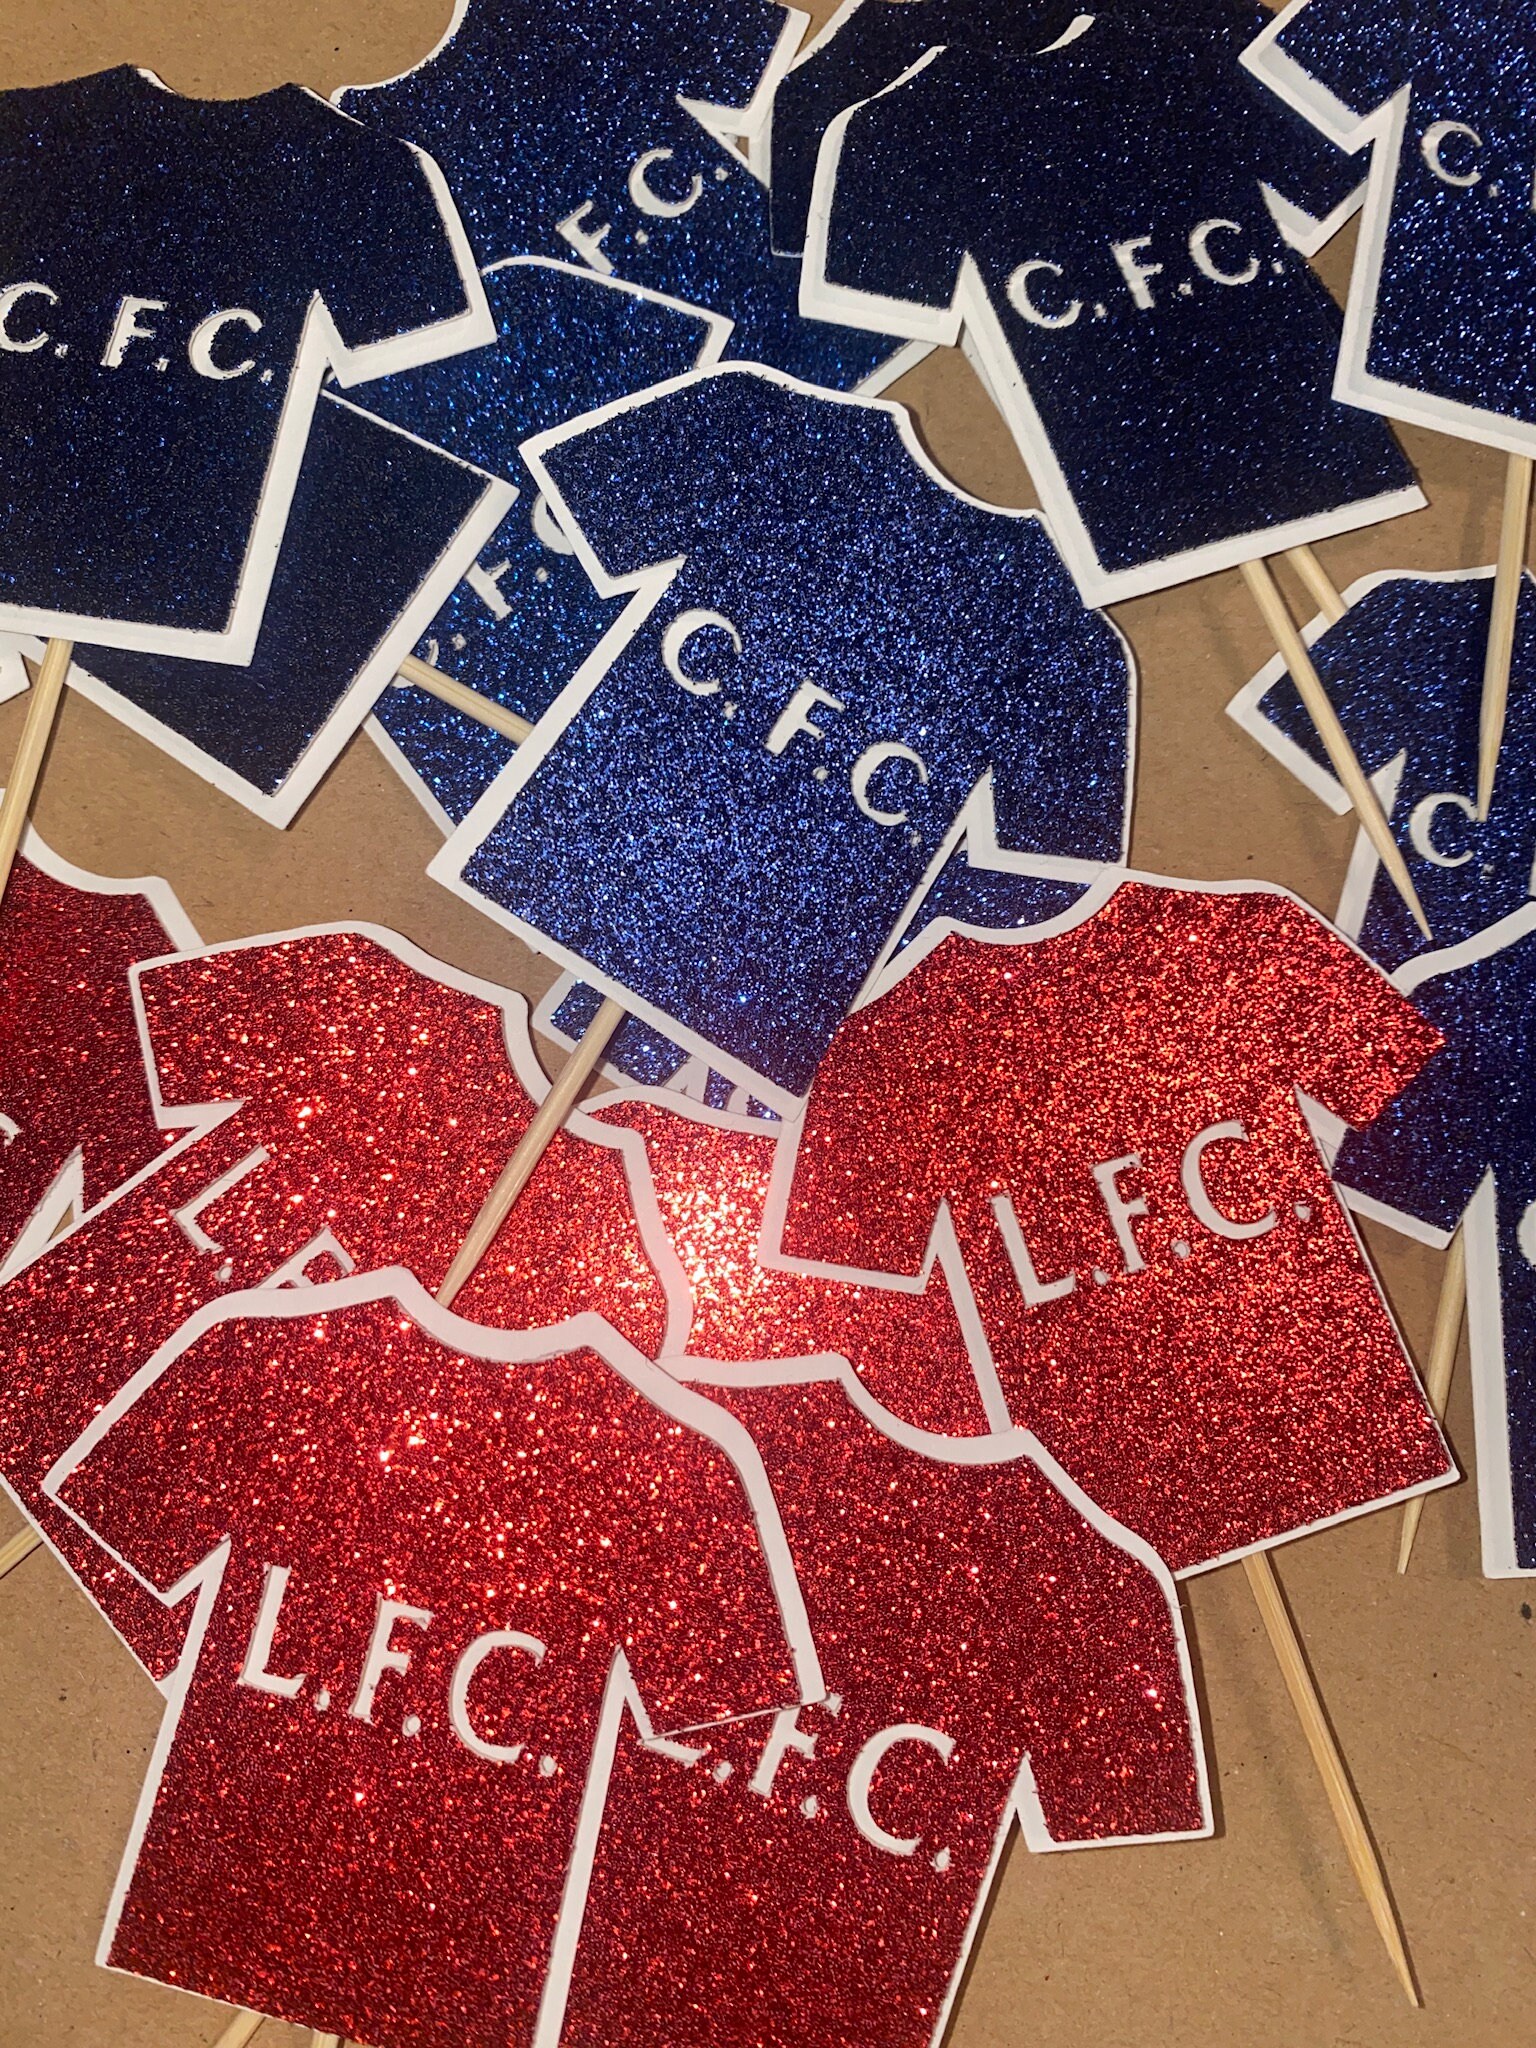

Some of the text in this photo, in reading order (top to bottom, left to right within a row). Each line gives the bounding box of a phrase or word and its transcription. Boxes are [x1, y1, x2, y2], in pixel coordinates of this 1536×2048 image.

[0, 281, 275, 385] C.F.C.
[1006, 218, 1285, 330] C.F.C.
[661, 608, 930, 848] C.F.C.
[988, 1119, 1312, 1309] L.F.C.
[237, 1564, 558, 1777] L.F.C.
